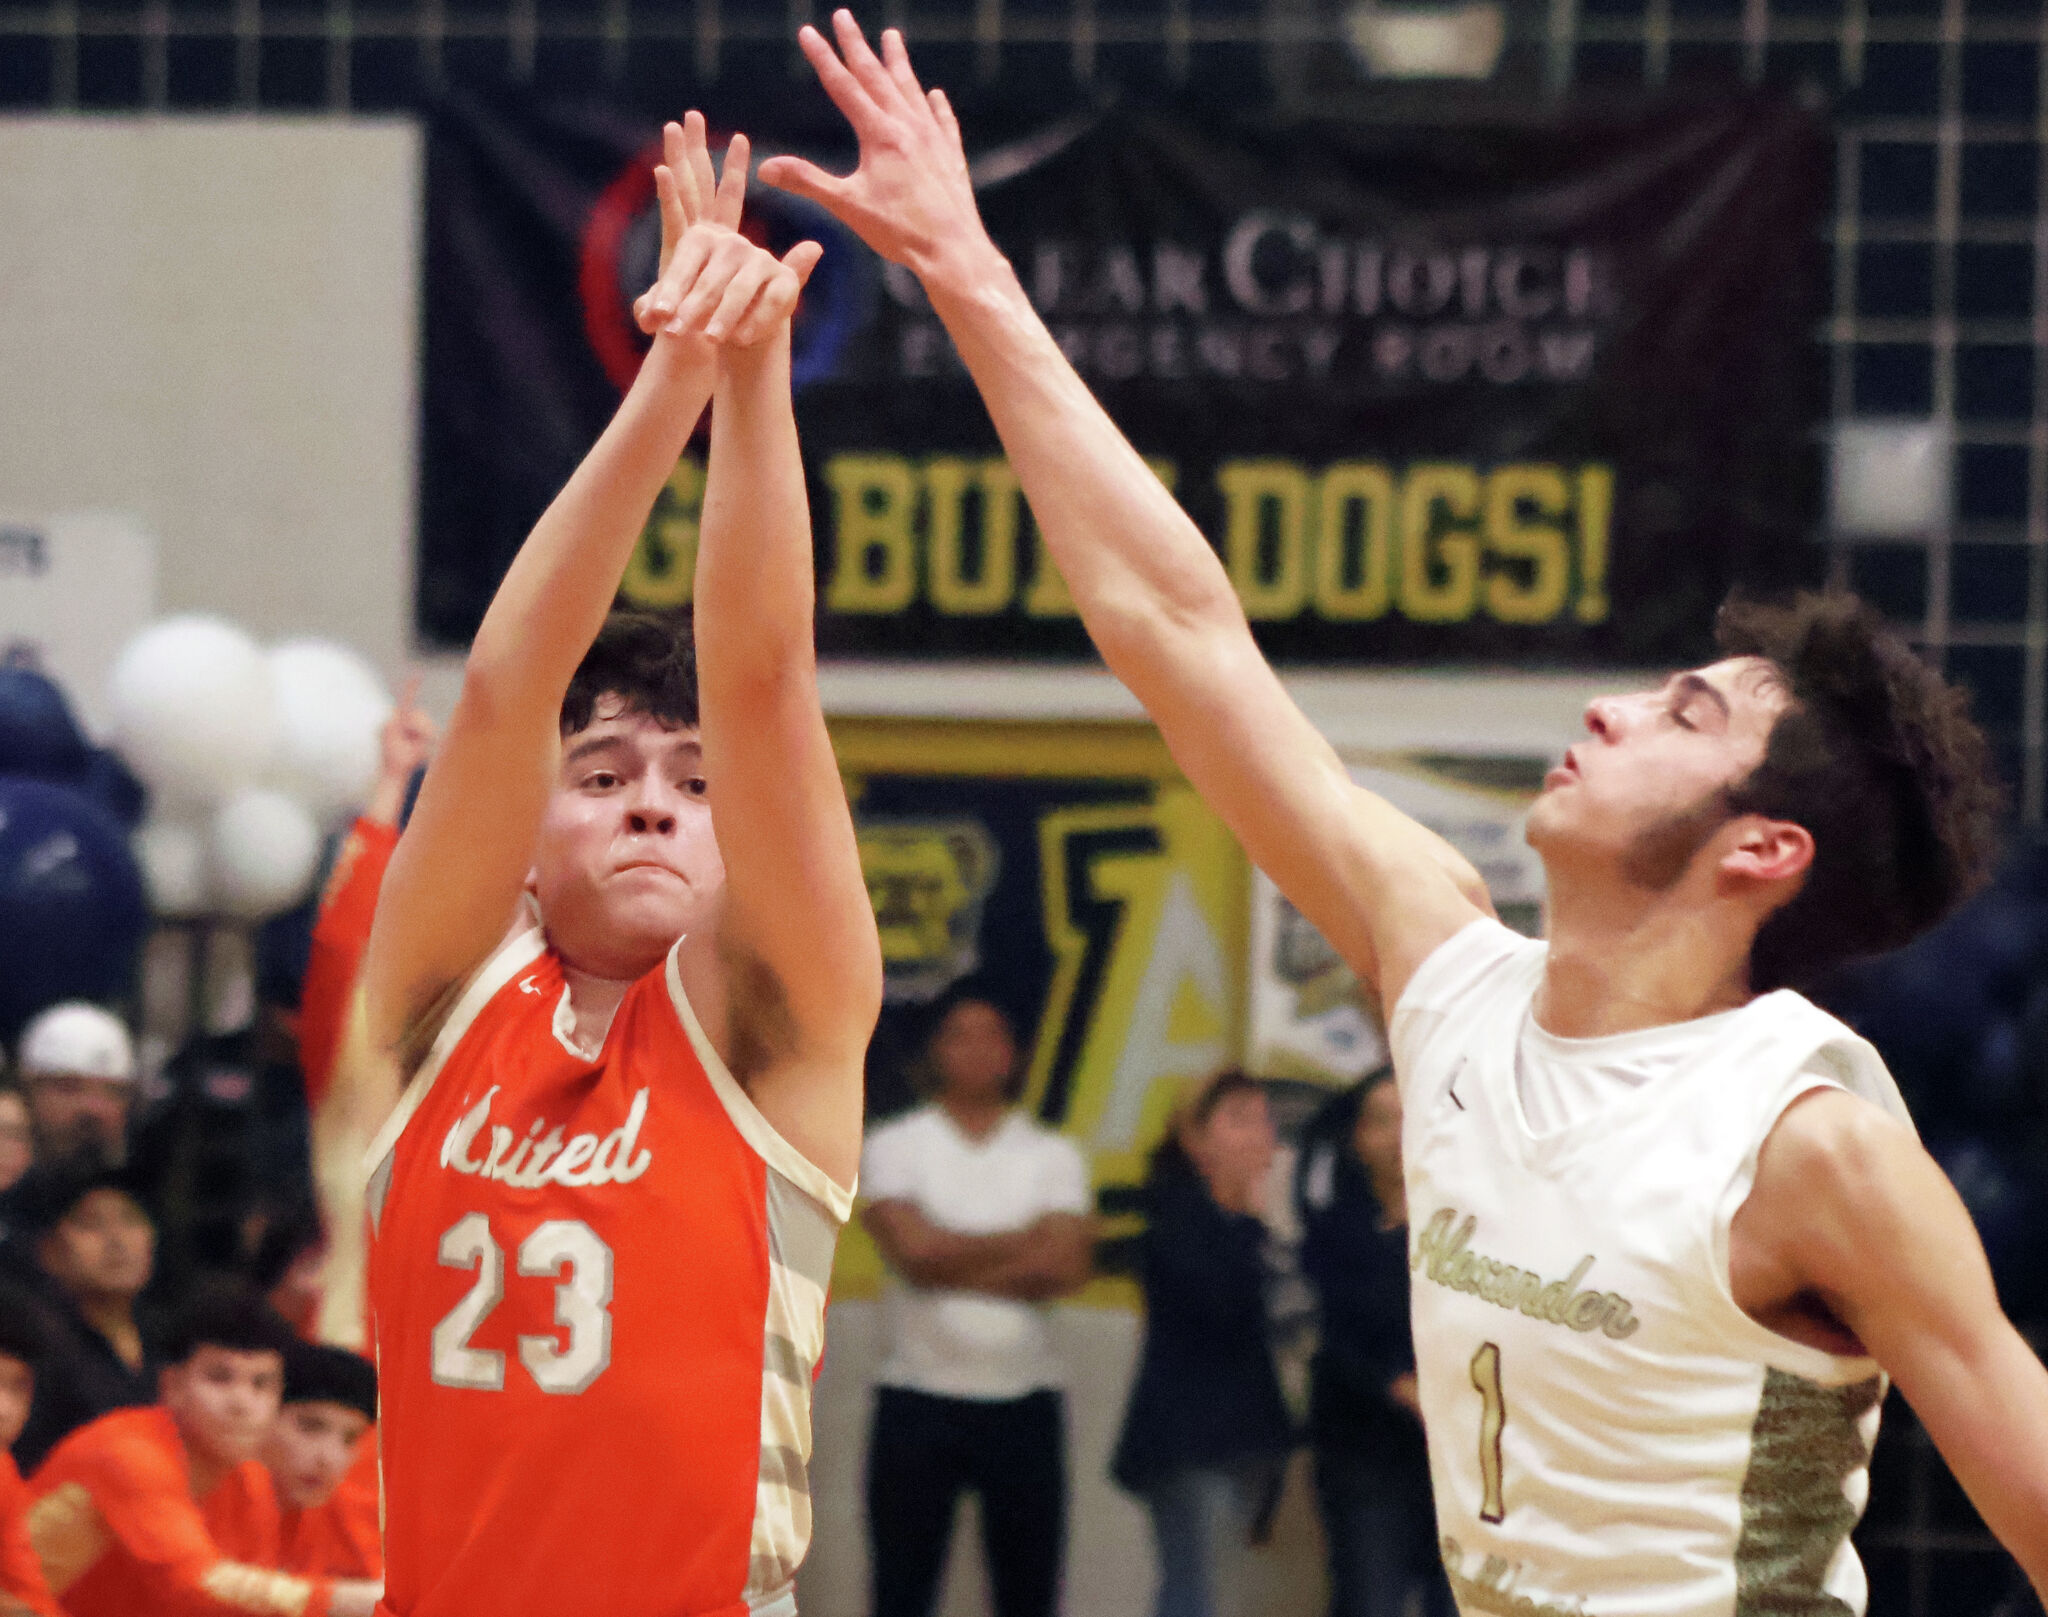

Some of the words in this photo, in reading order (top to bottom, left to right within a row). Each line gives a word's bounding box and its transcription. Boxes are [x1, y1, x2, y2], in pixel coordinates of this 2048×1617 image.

[880, 238, 1210, 314] EAR
[1218, 460, 1613, 624] DOGS!
[431, 1211, 614, 1396] 23
[1411, 1207, 1640, 1340] Alexander
[1470, 1341, 1506, 1525] 1
